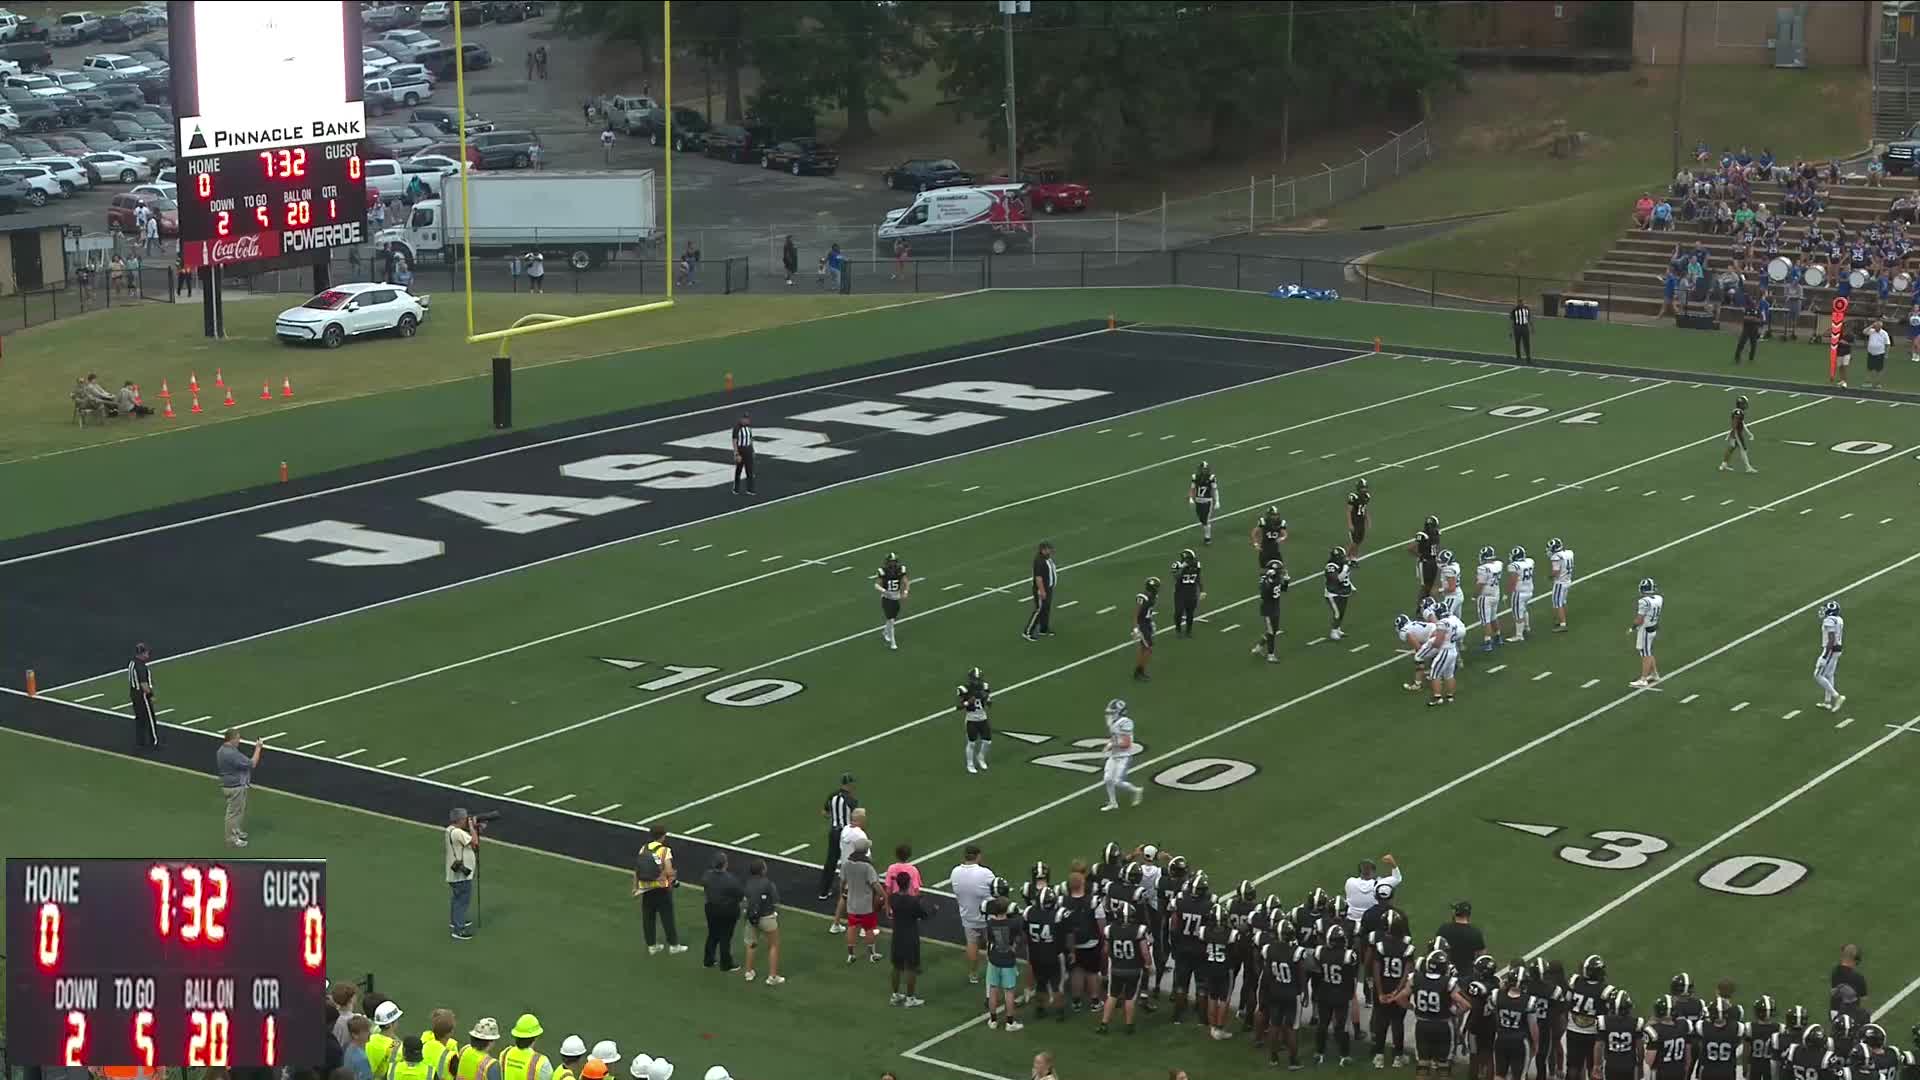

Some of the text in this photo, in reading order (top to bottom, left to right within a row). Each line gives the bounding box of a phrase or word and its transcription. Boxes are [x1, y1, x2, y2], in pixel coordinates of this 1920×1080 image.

[215, 121, 360, 148] PINNACLE BANK
[325, 142, 358, 160] GUEST
[188, 158, 221, 175] HOME
[260, 147, 306, 178] 7:32
[350, 155, 361, 179] 0
[198, 173, 211, 197] 0
[284, 188, 312, 203] BALL ON
[322, 185, 338, 199] QTR
[210, 197, 235, 212] DOWN
[243, 194, 267, 207] TO GO
[329, 199, 336, 218] 1
[217, 211, 229, 235] 2
[287, 201, 310, 225] 20
[283, 222, 361, 253] POWERADE
[257, 379, 1116, 568] JASPER
[887, 579, 899, 591] 15
[1029, 923, 1054, 942] 54
[1182, 912, 1202, 936] 77
[1112, 940, 1136, 960] 60
[1321, 963, 1343, 985] 16
[1383, 957, 1403, 979] 19
[1416, 989, 1441, 1013] 69
[1572, 993, 1597, 1016] 74
[1499, 1008, 1522, 1029] 67
[1608, 1031, 1633, 1053] 62
[1663, 1037, 1686, 1062] 70
[1706, 1041, 1733, 1062] 66
